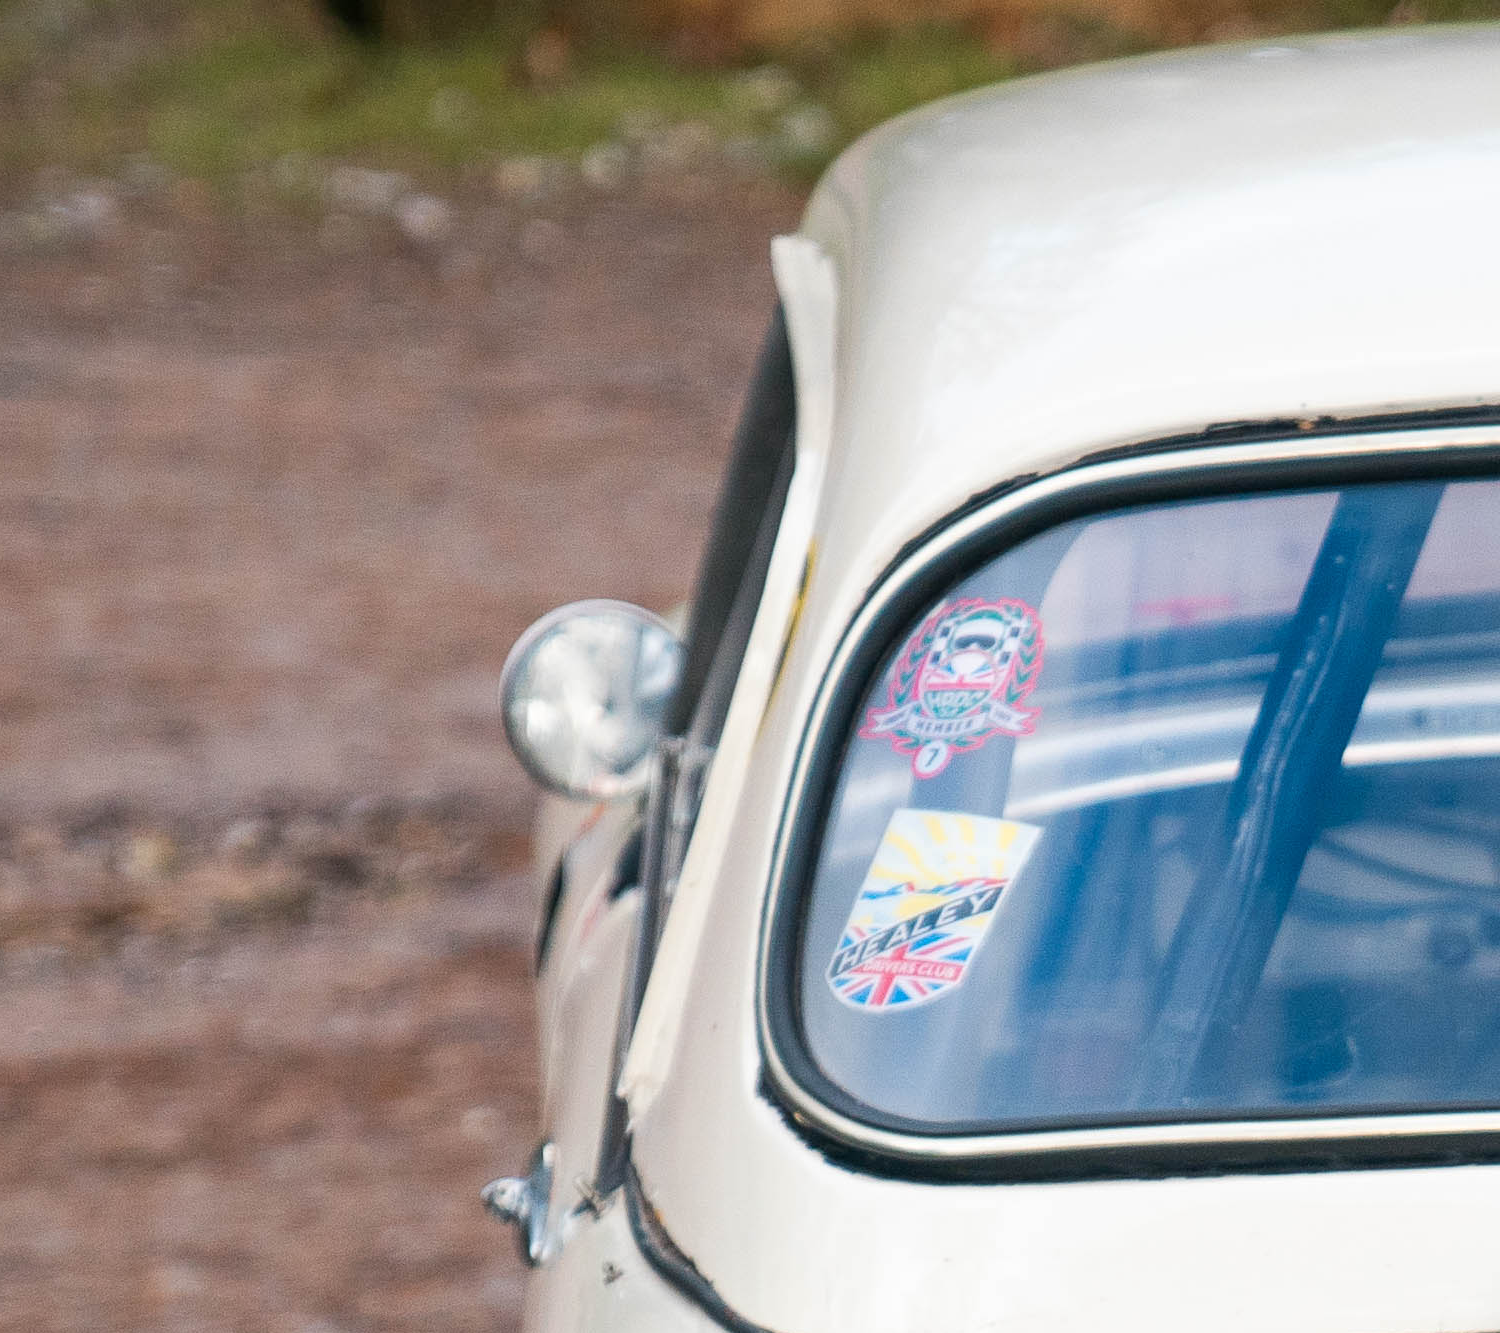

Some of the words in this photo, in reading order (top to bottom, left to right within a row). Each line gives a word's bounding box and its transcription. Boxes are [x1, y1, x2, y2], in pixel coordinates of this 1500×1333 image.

[925, 748, 939, 768] 7
[837, 888, 998, 975] HEALEY
[917, 962, 956, 978] CLUB
